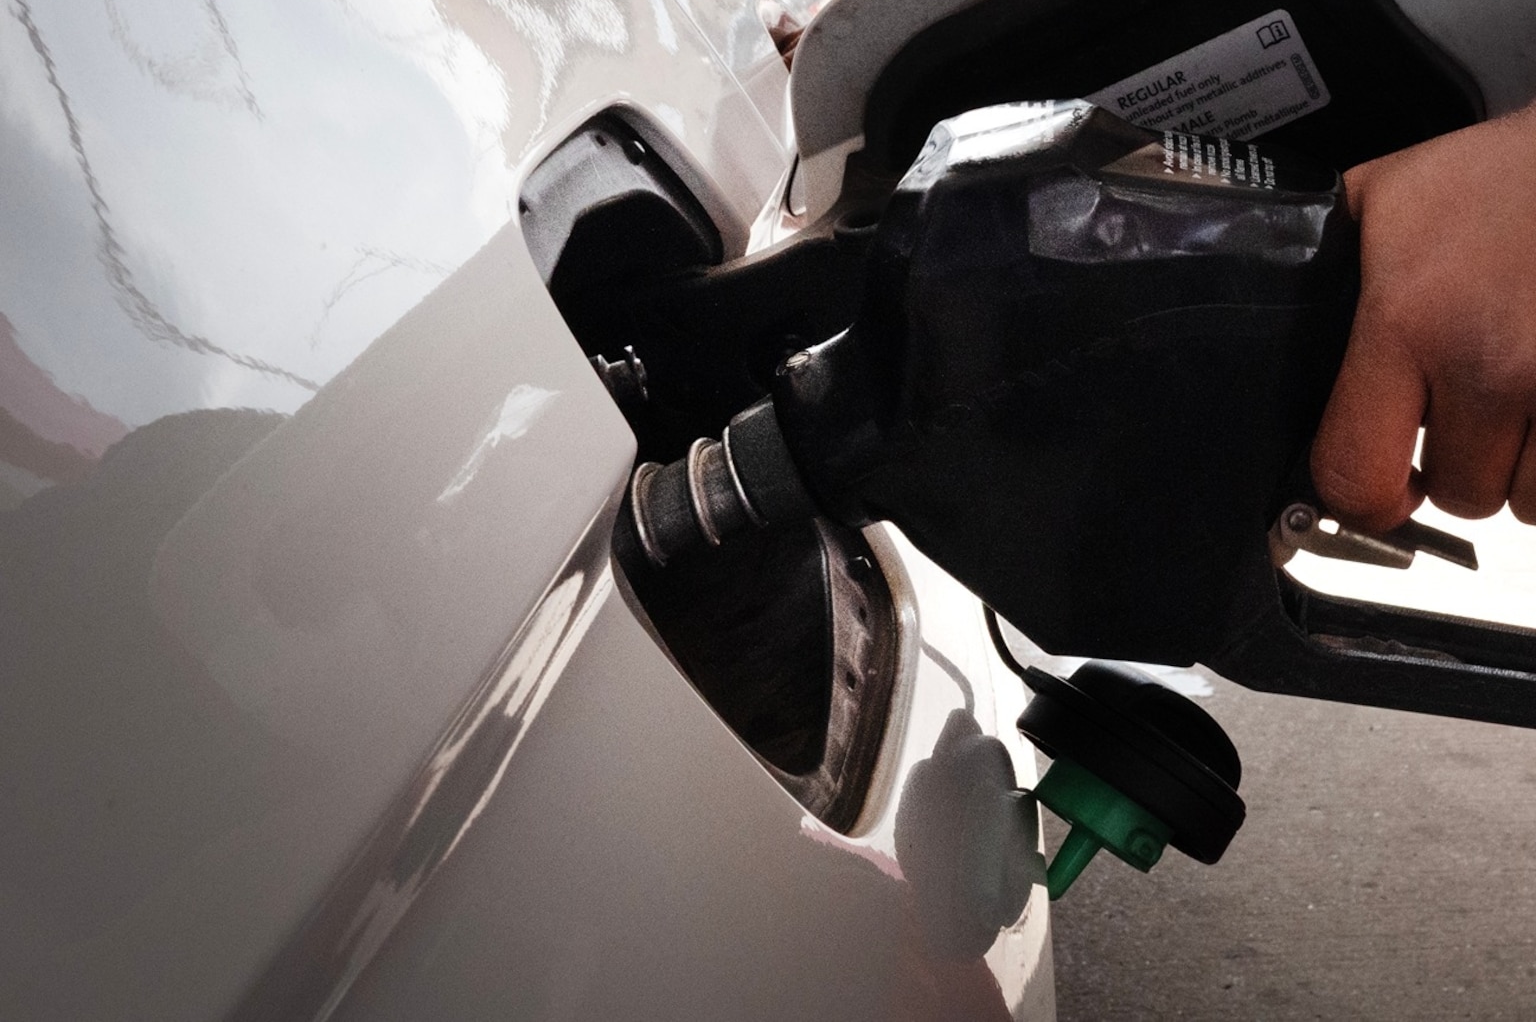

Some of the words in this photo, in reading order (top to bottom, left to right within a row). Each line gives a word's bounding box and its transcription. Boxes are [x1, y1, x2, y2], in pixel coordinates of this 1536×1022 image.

[1117, 71, 1186, 110] REGULAR
[1125, 90, 1175, 122] unleaded
[1175, 84, 1197, 104] fuel
[1198, 73, 1221, 90] only
[1138, 109, 1177, 127] ithout
[1176, 100, 1194, 116] any
[1196, 81, 1239, 106] metallic
[1240, 60, 1287, 85] additives
[1172, 111, 1215, 133] MALE
[1207, 122, 1222, 136] ans
[1224, 109, 1258, 128] Plomb
[1225, 125, 1251, 140] dditif
[1254, 99, 1309, 130] métallique
